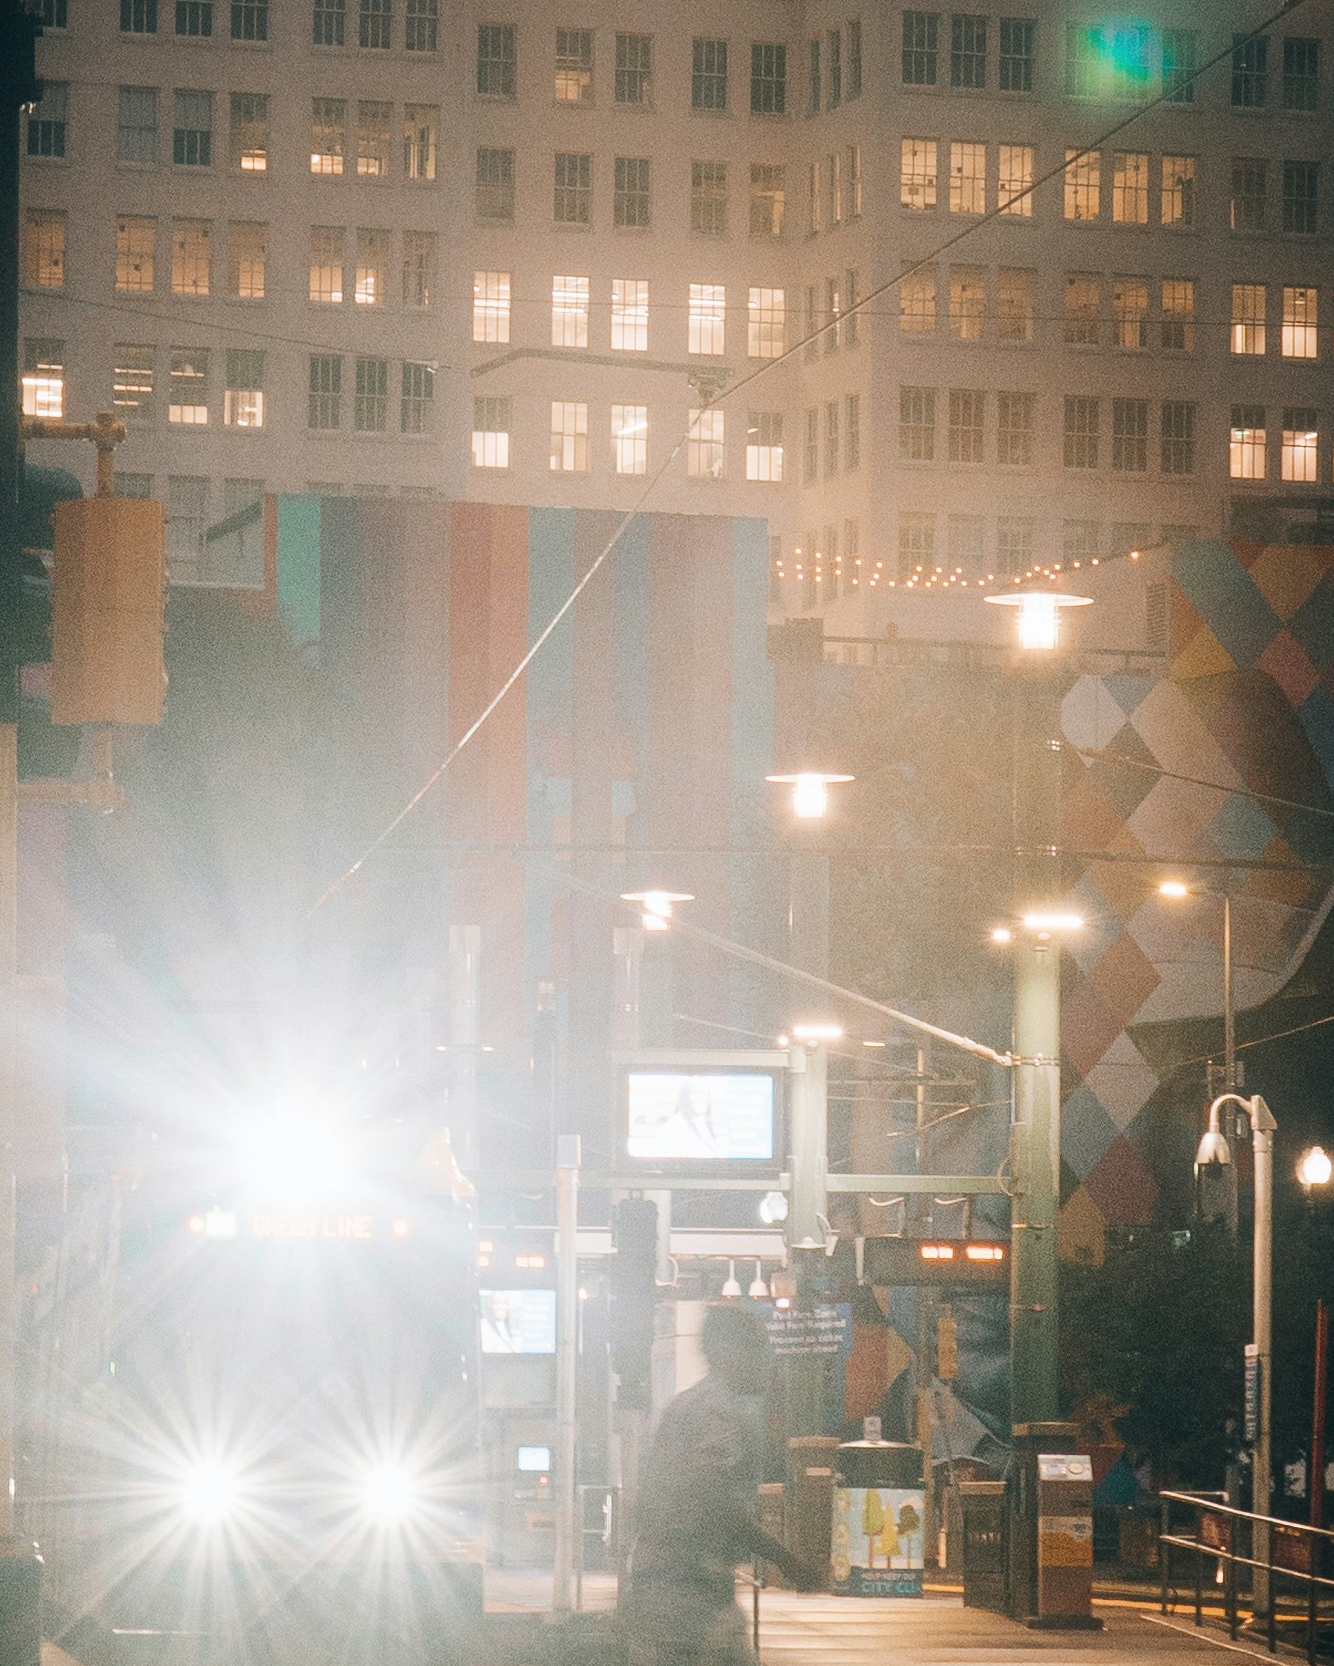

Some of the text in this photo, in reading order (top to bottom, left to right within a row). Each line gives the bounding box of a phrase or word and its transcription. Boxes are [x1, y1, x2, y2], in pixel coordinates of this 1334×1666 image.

[251, 1212, 372, 1238] GREEN LINE
[862, 1581, 892, 1593] CITY
